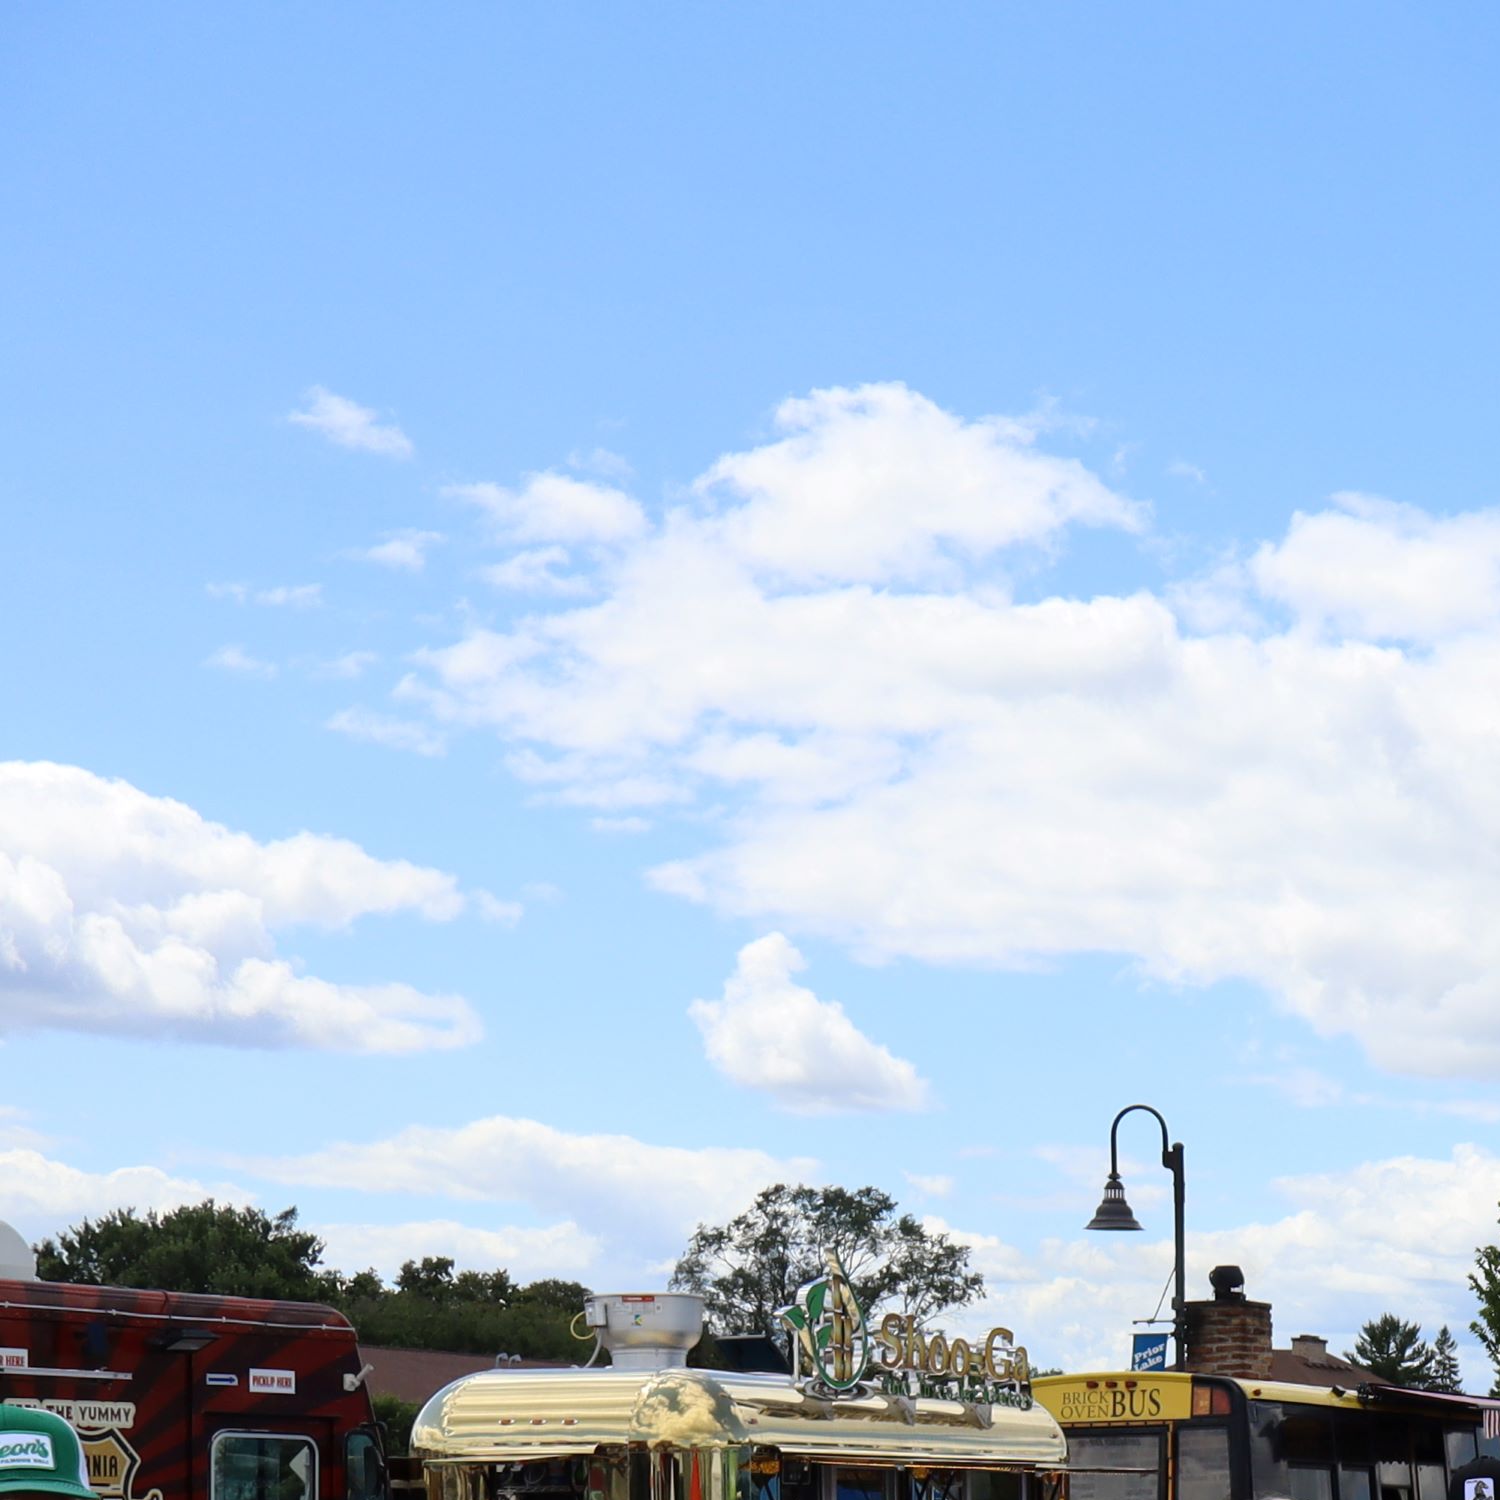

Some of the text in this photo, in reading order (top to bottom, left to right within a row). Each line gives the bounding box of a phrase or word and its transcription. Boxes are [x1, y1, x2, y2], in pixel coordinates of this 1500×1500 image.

[1134, 1341, 1166, 1362] Prior
[6, 1356, 25, 1367] HERE
[1134, 1354, 1164, 1371] Lake
[252, 1374, 292, 1389] PICKUP HERE
[1062, 1390, 1108, 1405] BRICK
[1111, 1388, 1161, 1418] BUS
[79, 1406, 132, 1422] YUMMY
[1060, 1405, 1109, 1419] OVEN
[0, 1439, 50, 1458] eon's
